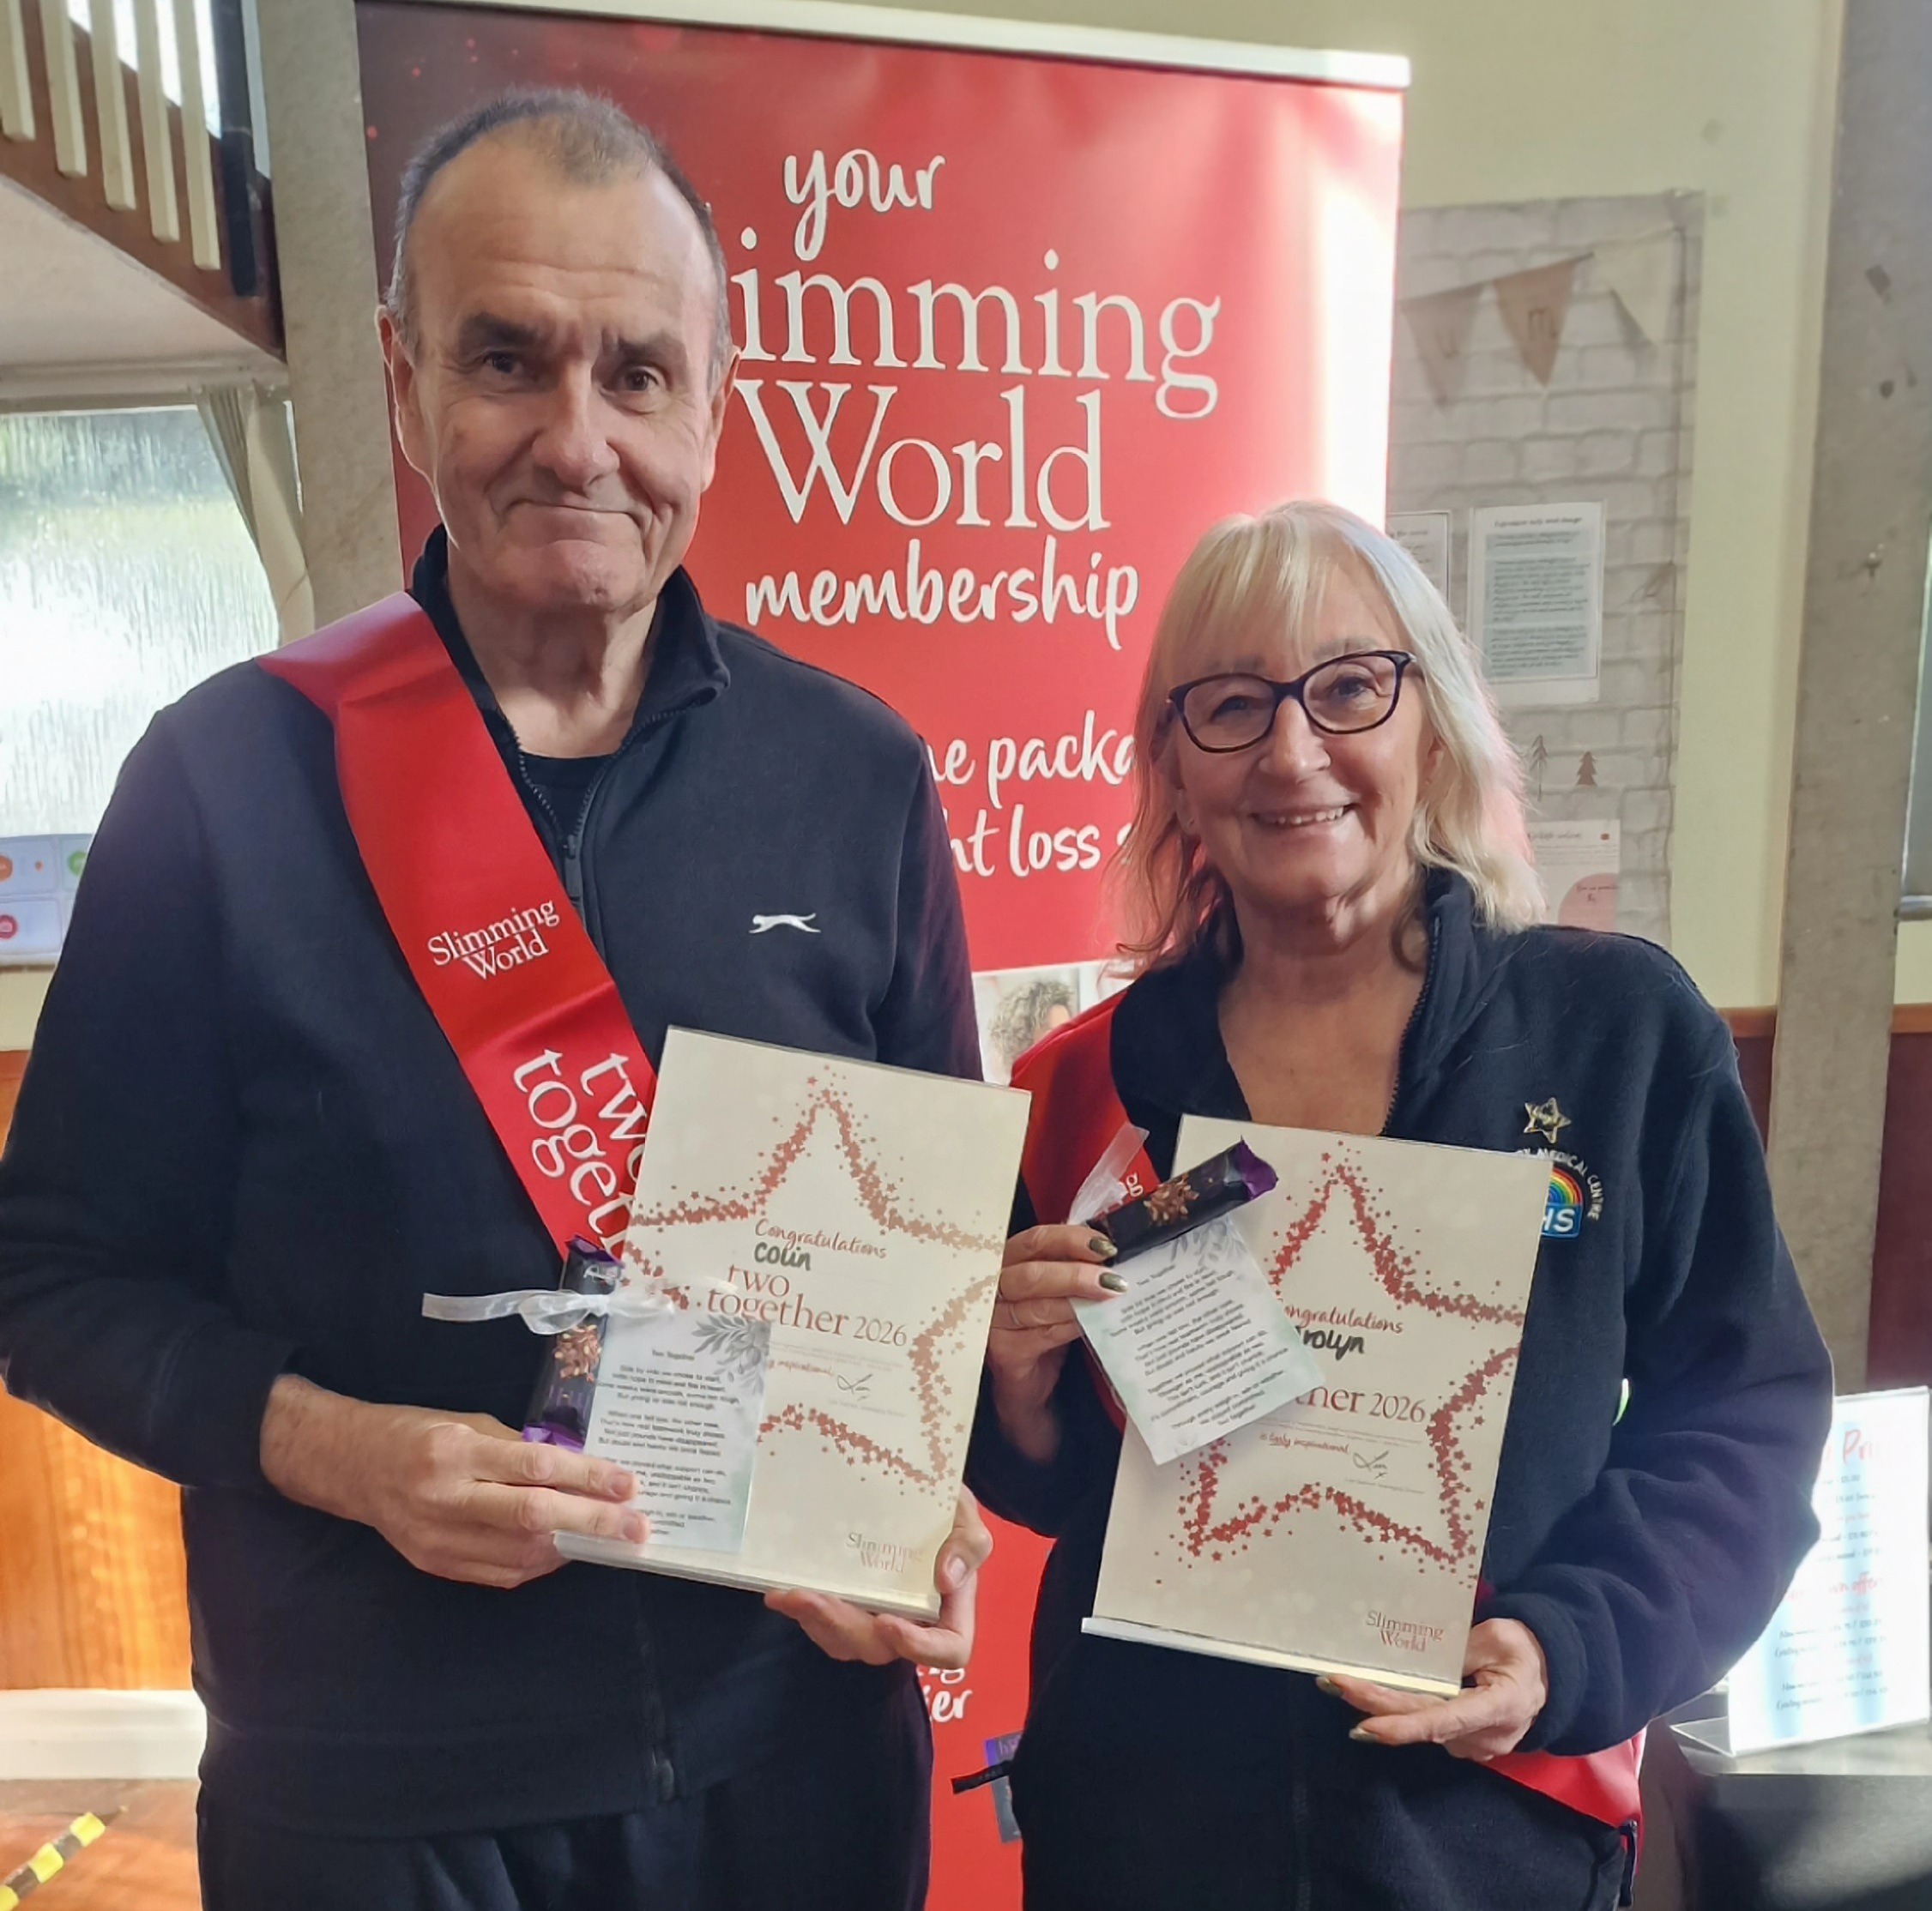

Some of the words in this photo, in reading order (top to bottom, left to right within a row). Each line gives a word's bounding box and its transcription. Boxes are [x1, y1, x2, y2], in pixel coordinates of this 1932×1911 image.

[783, 149, 945, 261] your
[730, 226, 1222, 419] imming
[734, 377, 1112, 533] World
[746, 534, 1139, 650] membership
[987, 709, 1136, 810] packa
[1009, 803, 1102, 877] loss
[426, 900, 560, 967] Slimming
[462, 930, 550, 980] World
[755, 1217, 887, 1259] Congratulations
[728, 1263, 790, 1297] two
[706, 1288, 849, 1336] together
[853, 1316, 908, 1347] 2026
[1283, 1305, 1404, 1335] ongratulations
[1369, 1392, 1426, 1423] 2026
[1365, 1609, 1445, 1642] Slimming
[1380, 1629, 1426, 1653] World
